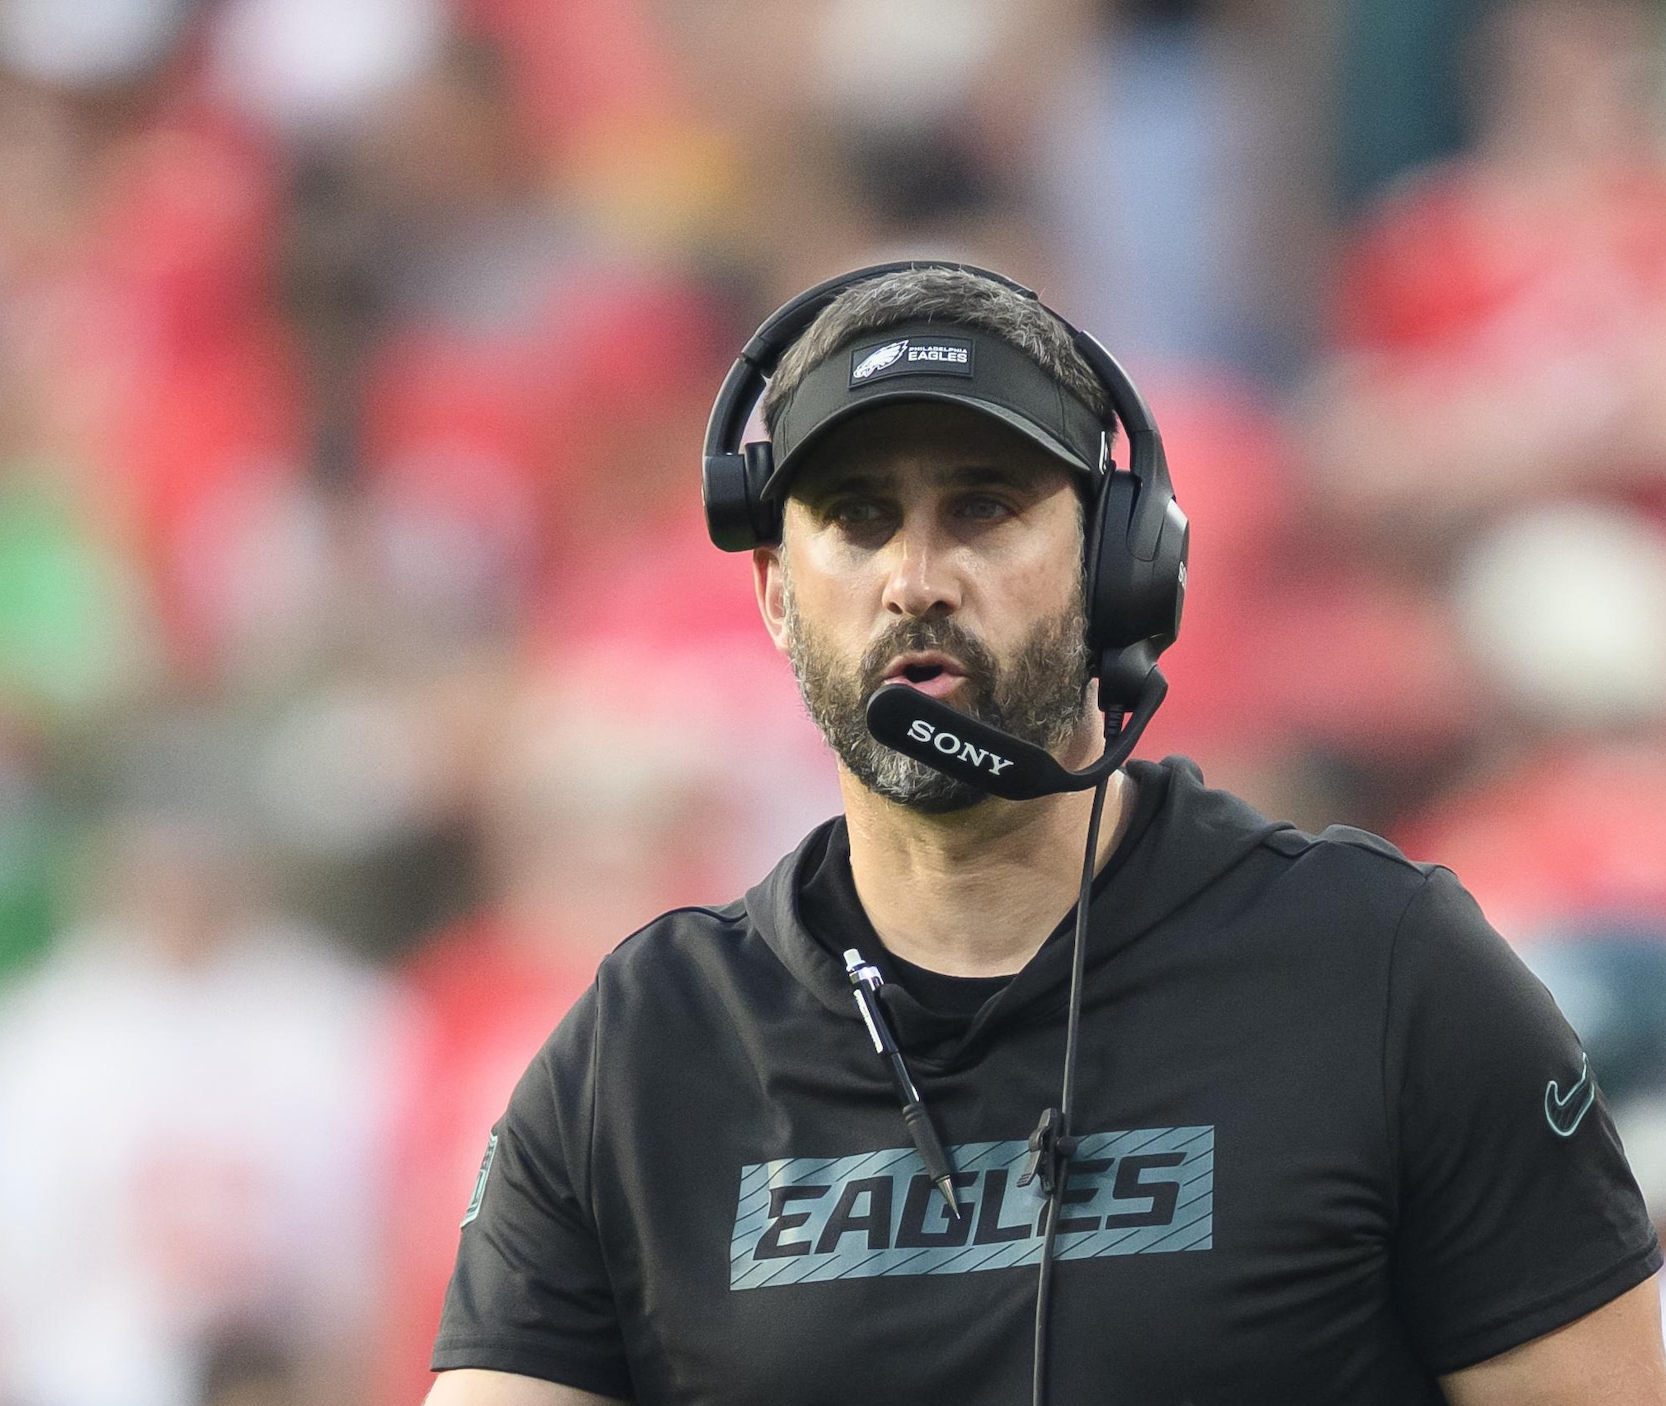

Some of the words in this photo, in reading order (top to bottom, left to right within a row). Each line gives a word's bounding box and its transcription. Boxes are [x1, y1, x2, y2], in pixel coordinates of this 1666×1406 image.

[908, 352, 968, 363] EAGLES
[907, 720, 1015, 776] SONY
[753, 1151, 1188, 1261] EAGLES
